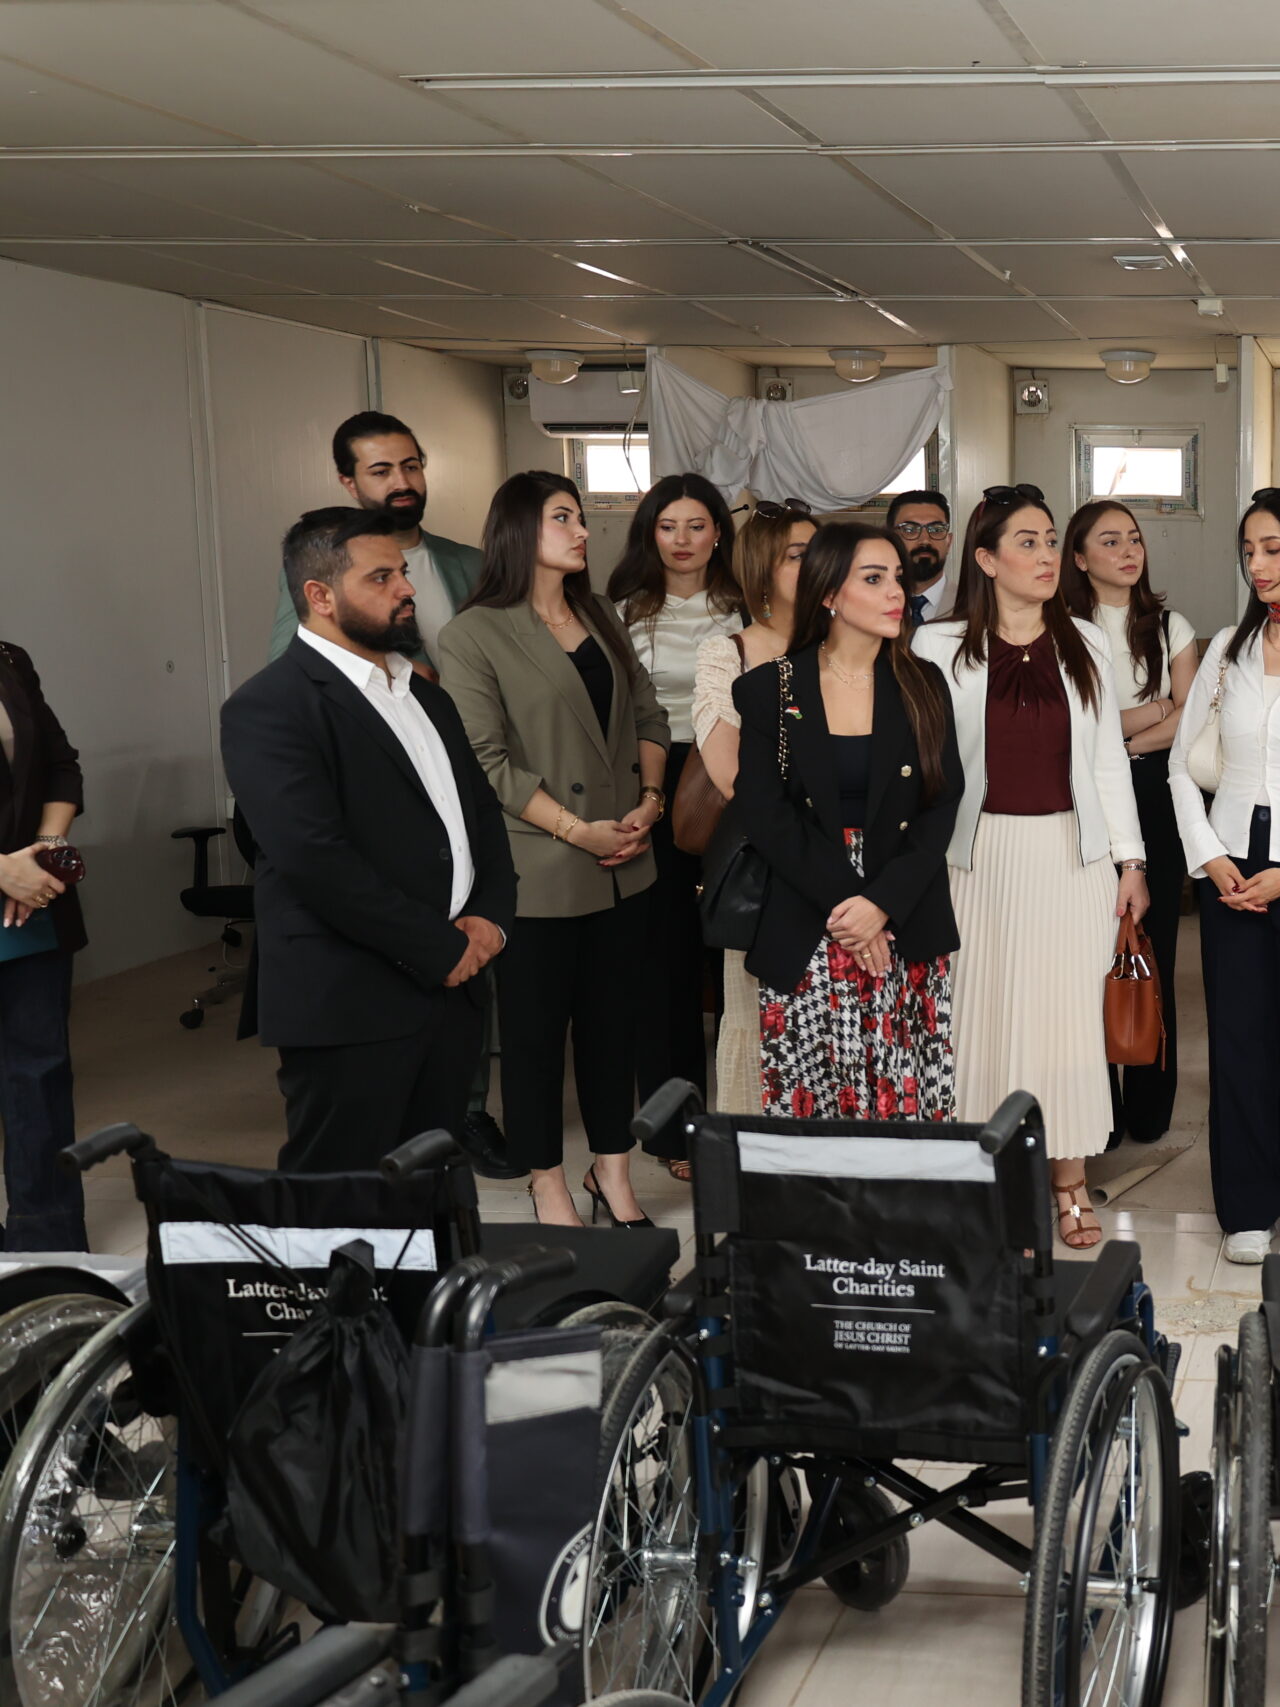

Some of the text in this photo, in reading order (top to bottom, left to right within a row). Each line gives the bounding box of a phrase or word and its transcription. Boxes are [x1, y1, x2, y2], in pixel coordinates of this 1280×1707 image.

[804, 1254, 946, 1280] Latter-day Saint
[832, 1276, 916, 1298] Charities
[833, 1320, 912, 1333] THE CHURCH OF
[833, 1330, 911, 1345] JESUS CHRIST
